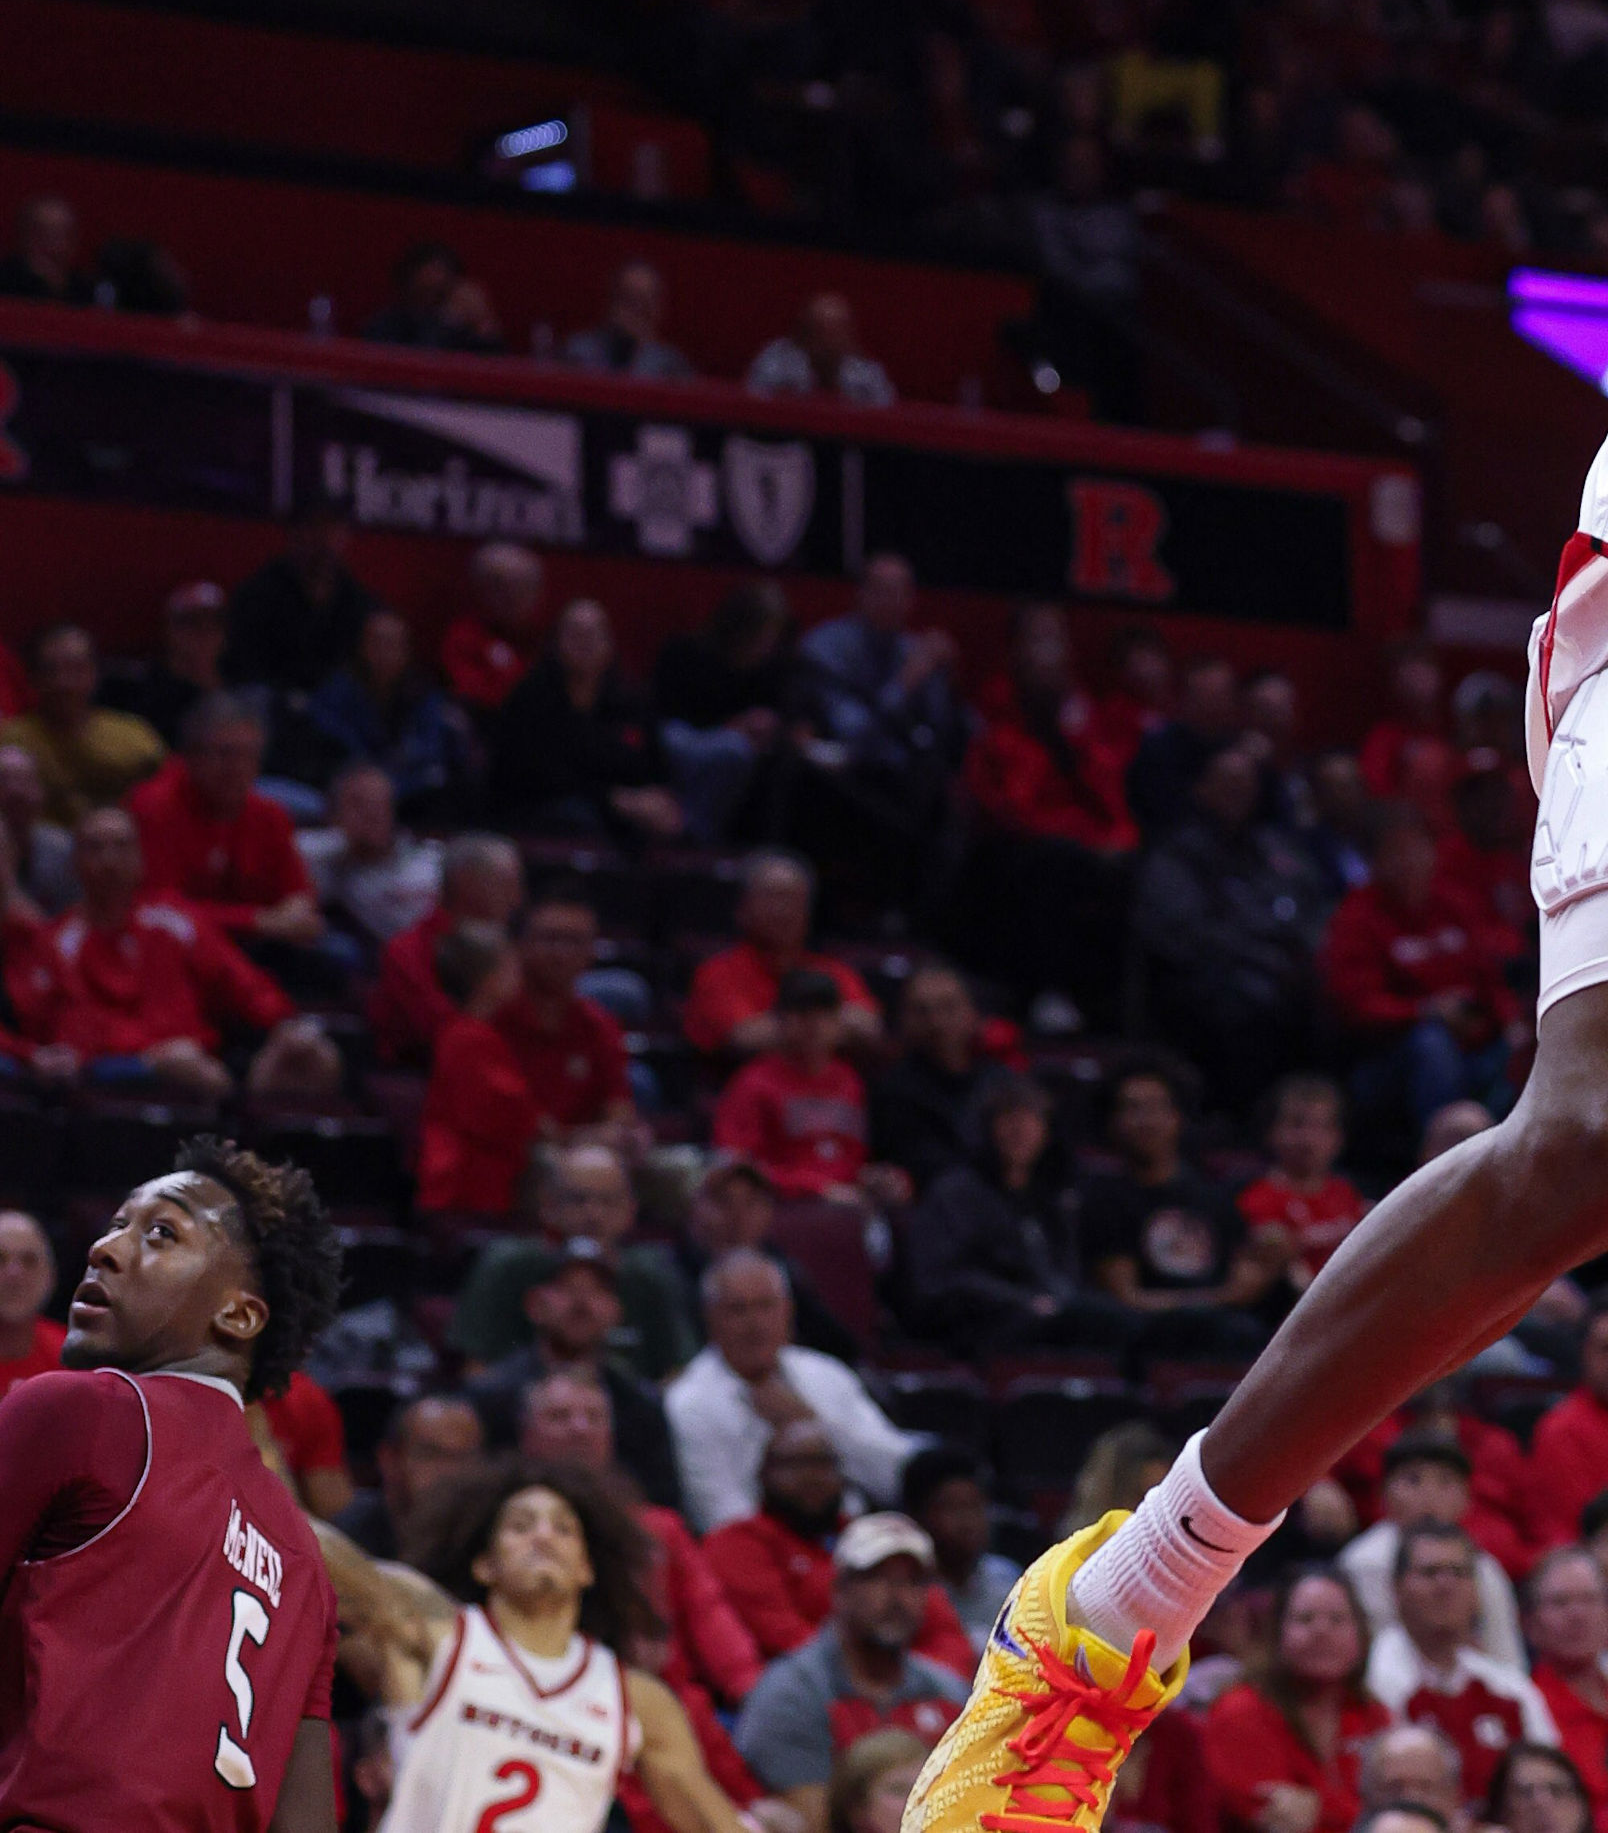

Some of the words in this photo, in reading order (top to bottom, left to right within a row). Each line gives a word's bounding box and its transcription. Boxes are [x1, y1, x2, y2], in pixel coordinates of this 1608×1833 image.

[1064, 475, 1178, 602] R
[213, 1586, 270, 1789] 5
[474, 1757, 542, 1833] 2
